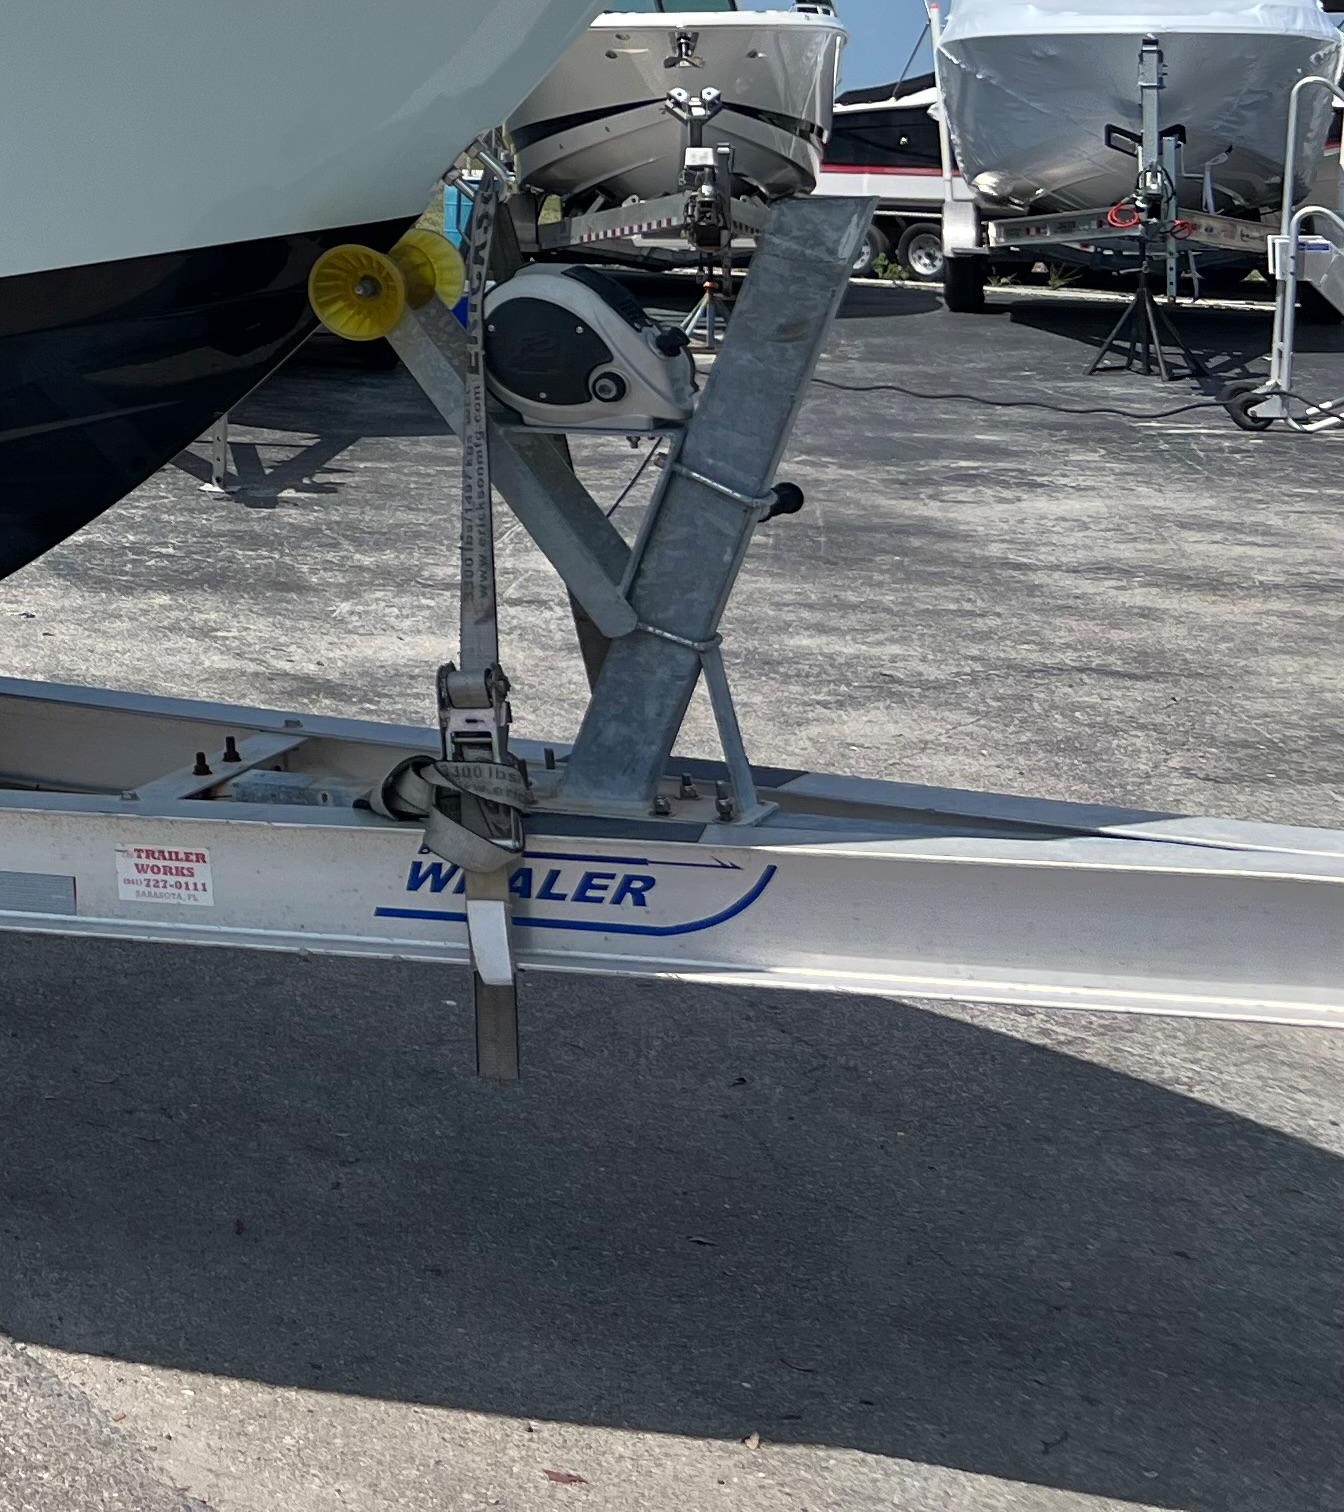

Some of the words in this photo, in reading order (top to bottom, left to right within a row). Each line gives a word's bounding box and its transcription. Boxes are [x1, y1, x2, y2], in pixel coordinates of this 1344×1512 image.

[133, 848, 207, 864] TRAILER
[134, 864, 195, 877] WORKS
[143, 878, 208, 892] 727-0111
[406, 860, 656, 907] WALER
